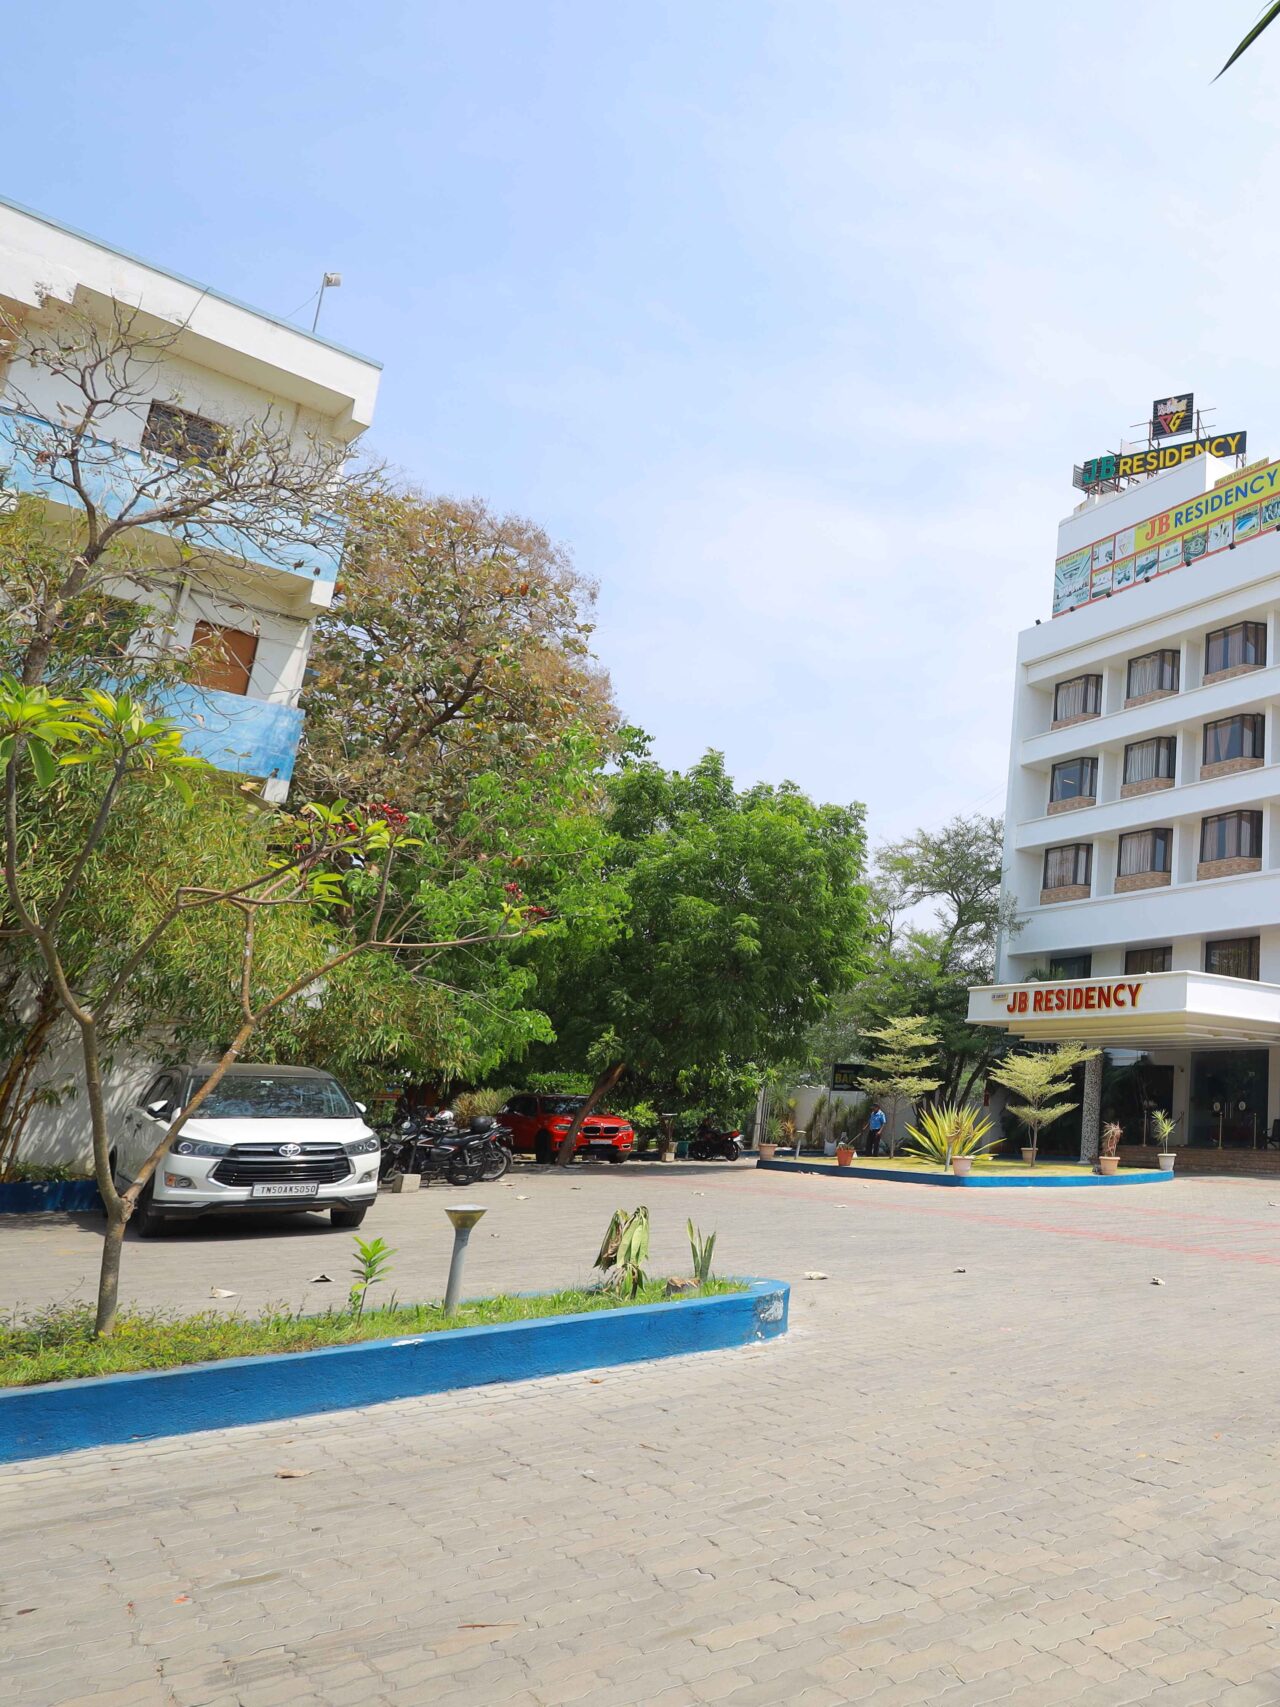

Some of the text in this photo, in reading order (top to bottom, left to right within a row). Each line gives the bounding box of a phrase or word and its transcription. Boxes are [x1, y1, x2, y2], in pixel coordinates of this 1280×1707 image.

[1082, 455, 1116, 484] JB
[1118, 434, 1241, 476] RESIDENCY
[1145, 513, 1171, 541] JB
[1174, 471, 1278, 528] RESIDENCY
[1007, 983, 1142, 1013] JB RESIDENCY
